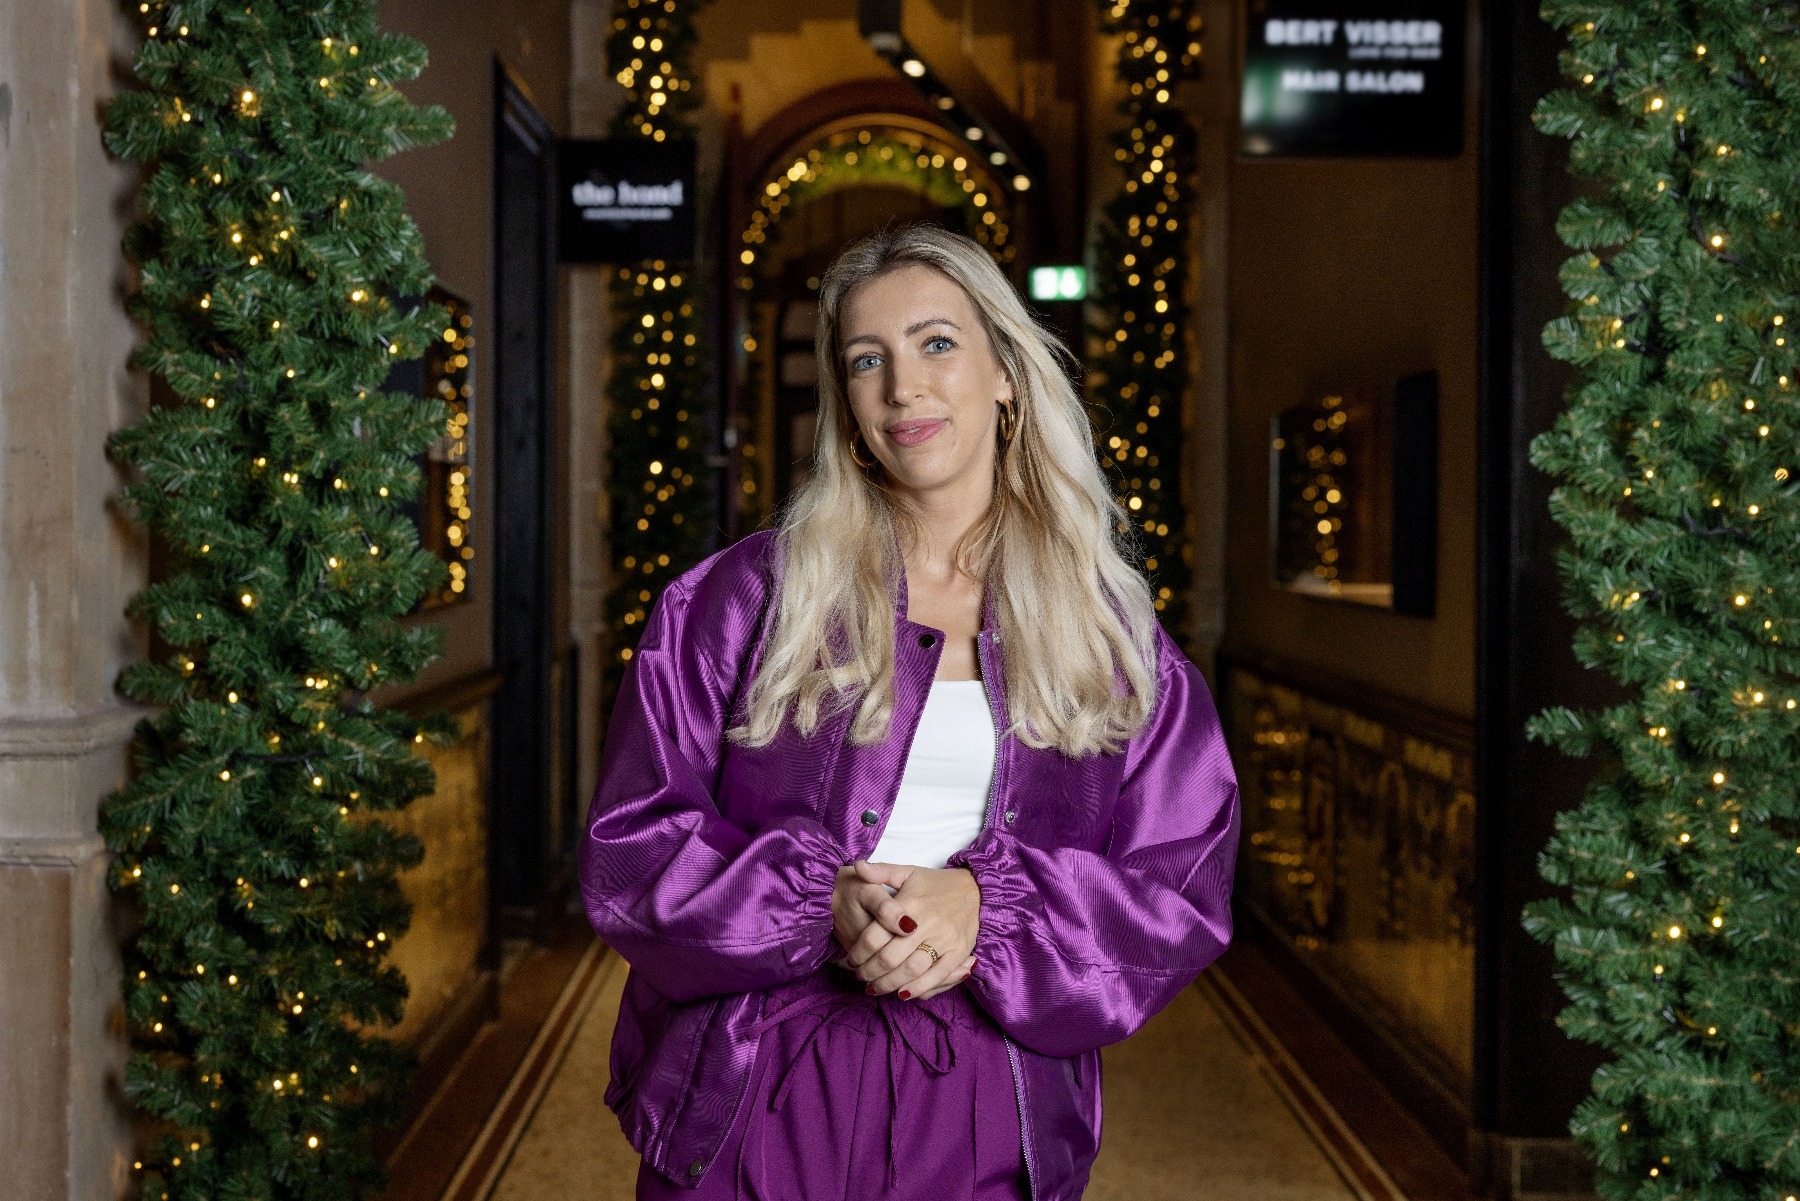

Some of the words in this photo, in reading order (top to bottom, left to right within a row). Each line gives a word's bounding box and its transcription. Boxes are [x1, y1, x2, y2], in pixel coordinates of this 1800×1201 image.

[1265, 19, 1338, 45] BERT
[1344, 20, 1442, 46] VISSER
[1282, 70, 1340, 93] HAIR
[1344, 71, 1424, 94] SALON
